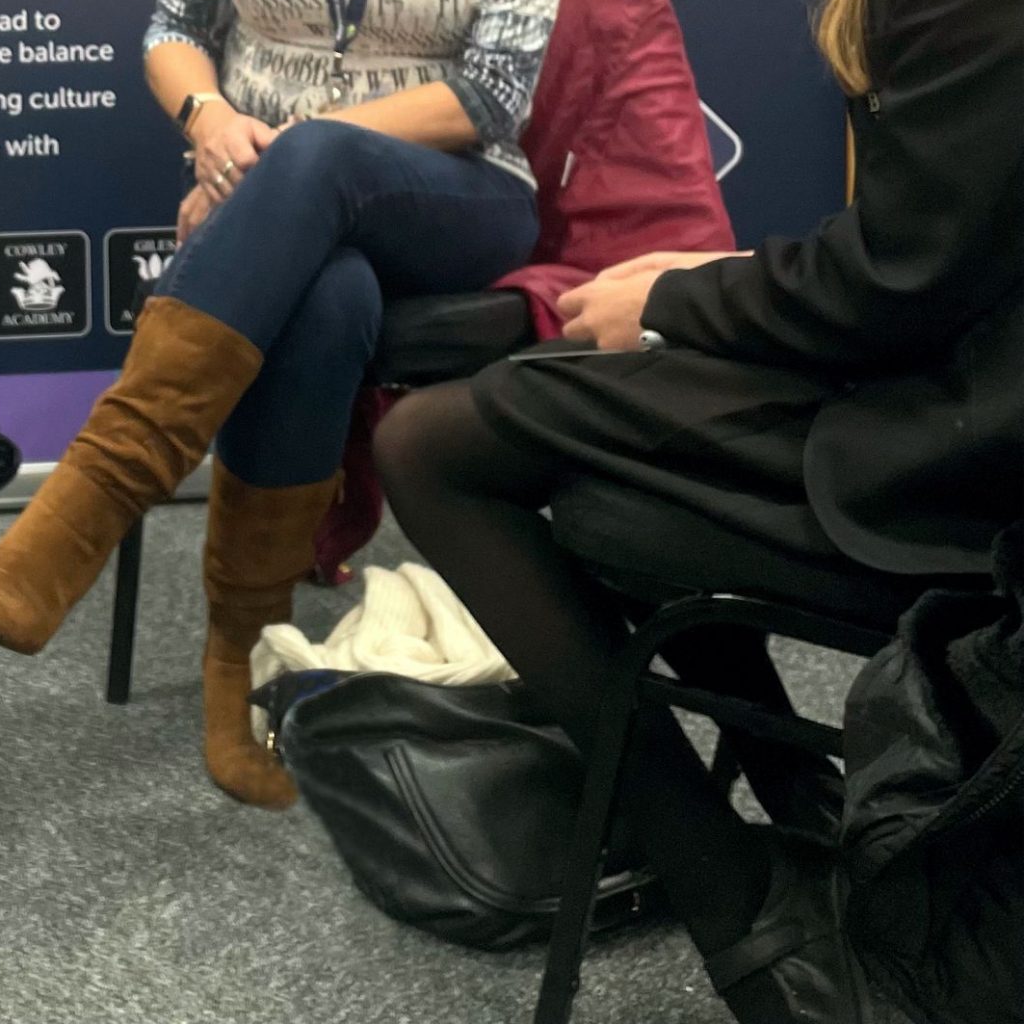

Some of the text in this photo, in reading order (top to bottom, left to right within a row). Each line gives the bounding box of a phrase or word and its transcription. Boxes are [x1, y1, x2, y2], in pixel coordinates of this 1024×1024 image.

[34, 10, 61, 31] to
[18, 40, 114, 63] balance
[28, 87, 116, 110] culture
[5, 134, 60, 157] with
